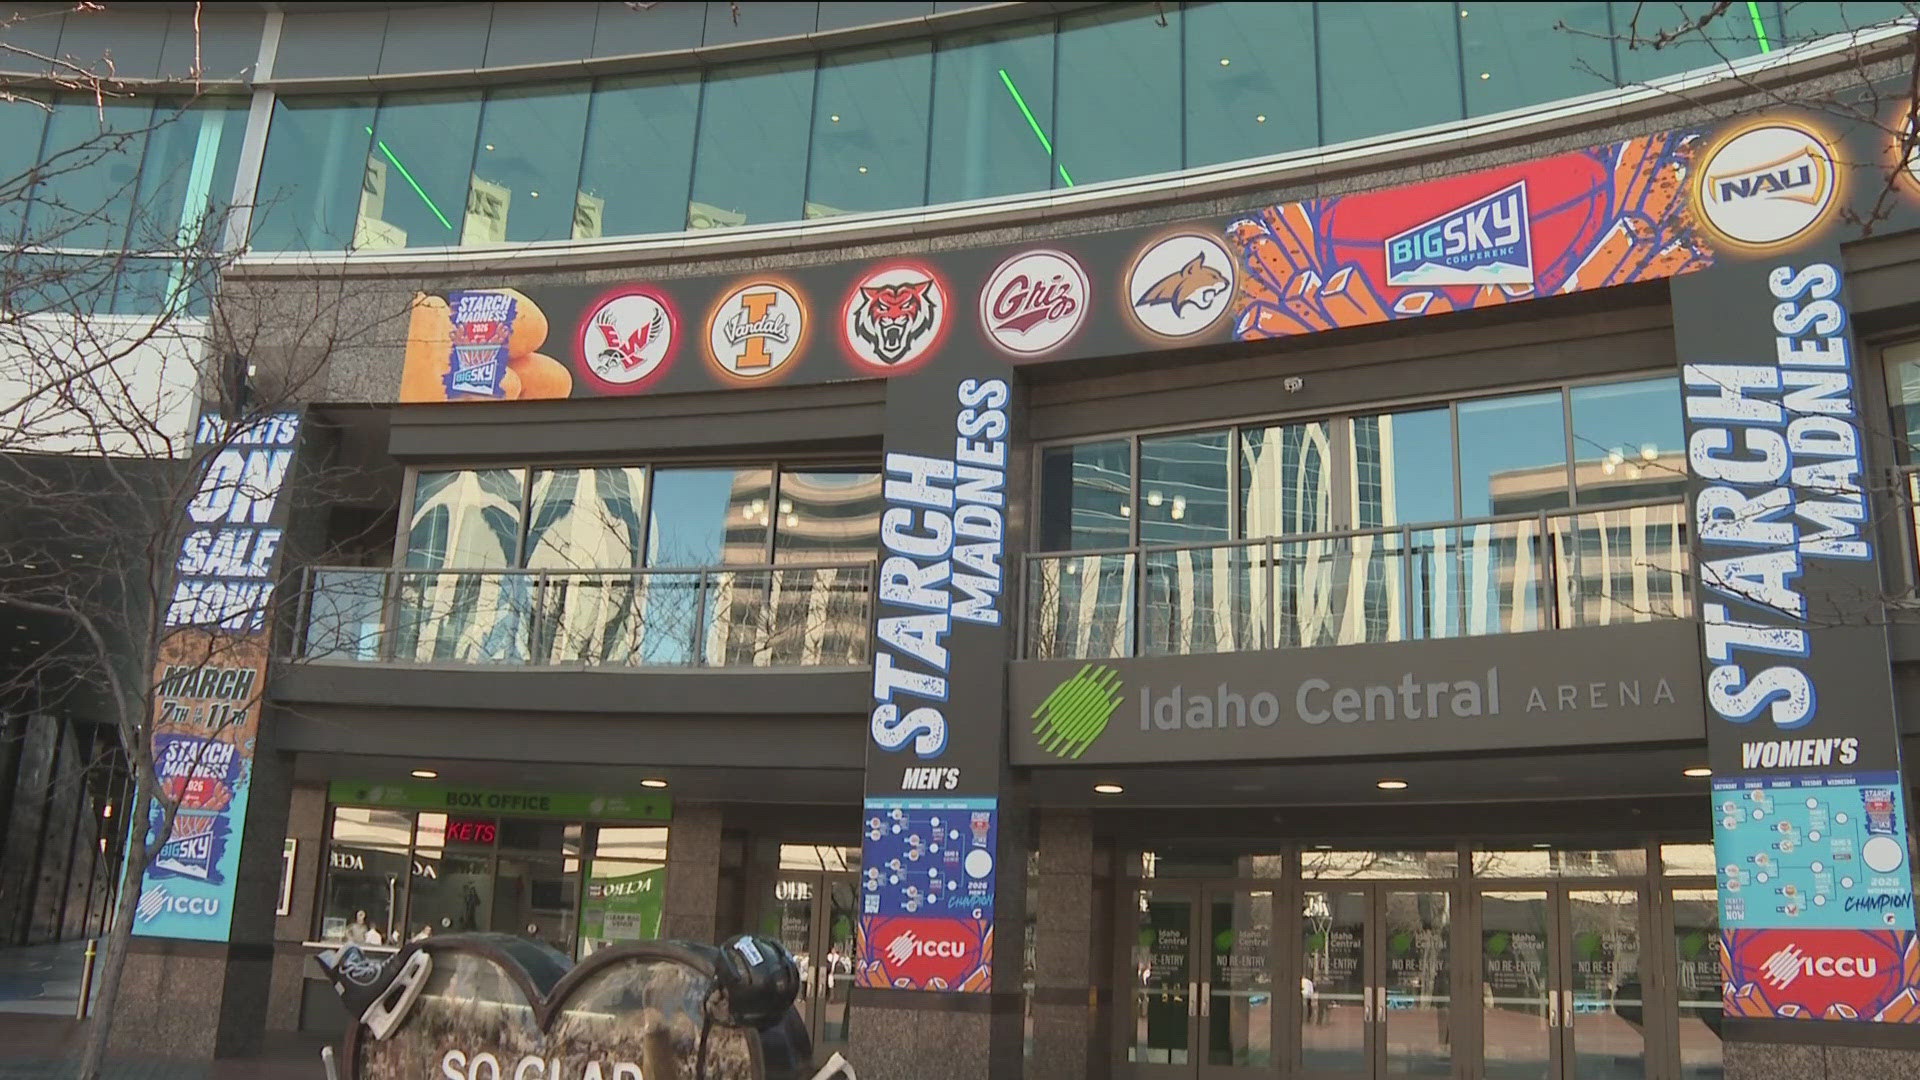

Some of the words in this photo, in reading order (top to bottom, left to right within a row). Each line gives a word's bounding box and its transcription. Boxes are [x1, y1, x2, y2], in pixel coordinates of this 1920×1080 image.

[1720, 165, 1811, 202] NAU
[459, 294, 512, 312] STARCH
[993, 273, 1075, 322] Griz
[456, 309, 508, 323] MADNESS
[472, 323, 489, 332] 2026
[724, 312, 788, 343] Vandals
[1769, 263, 1873, 560] MADNESS
[187, 448, 294, 523] ON
[951, 378, 1009, 625] MADNESS
[176, 526, 284, 577] SALE
[1683, 363, 1816, 730] STARCH
[165, 579, 275, 630] NOW!
[871, 451, 956, 759] STARCH
[158, 665, 258, 700] MARCH
[1140, 681, 1280, 731] Idaho
[1296, 666, 1500, 725] Central
[1526, 677, 1676, 713] ARENA
[159, 699, 190, 723] 7TH
[1741, 738, 1859, 769] WOMEN'S
[187, 780, 204, 791] 026
[901, 766, 961, 791] MEN'S
[446, 791, 483, 807] BOX
[487, 793, 551, 810] OFFICE
[166, 895, 219, 916] ICCU
[1844, 892, 1912, 913] CHAMPION
[1726, 911, 1745, 921] NOW
[1158, 936, 1188, 946] Central
[1330, 931, 1353, 940] Idaho
[1330, 939, 1361, 949] Central
[917, 940, 965, 959] ICCU
[1488, 960, 1501, 972] NO
[1804, 956, 1877, 979] ICCU
